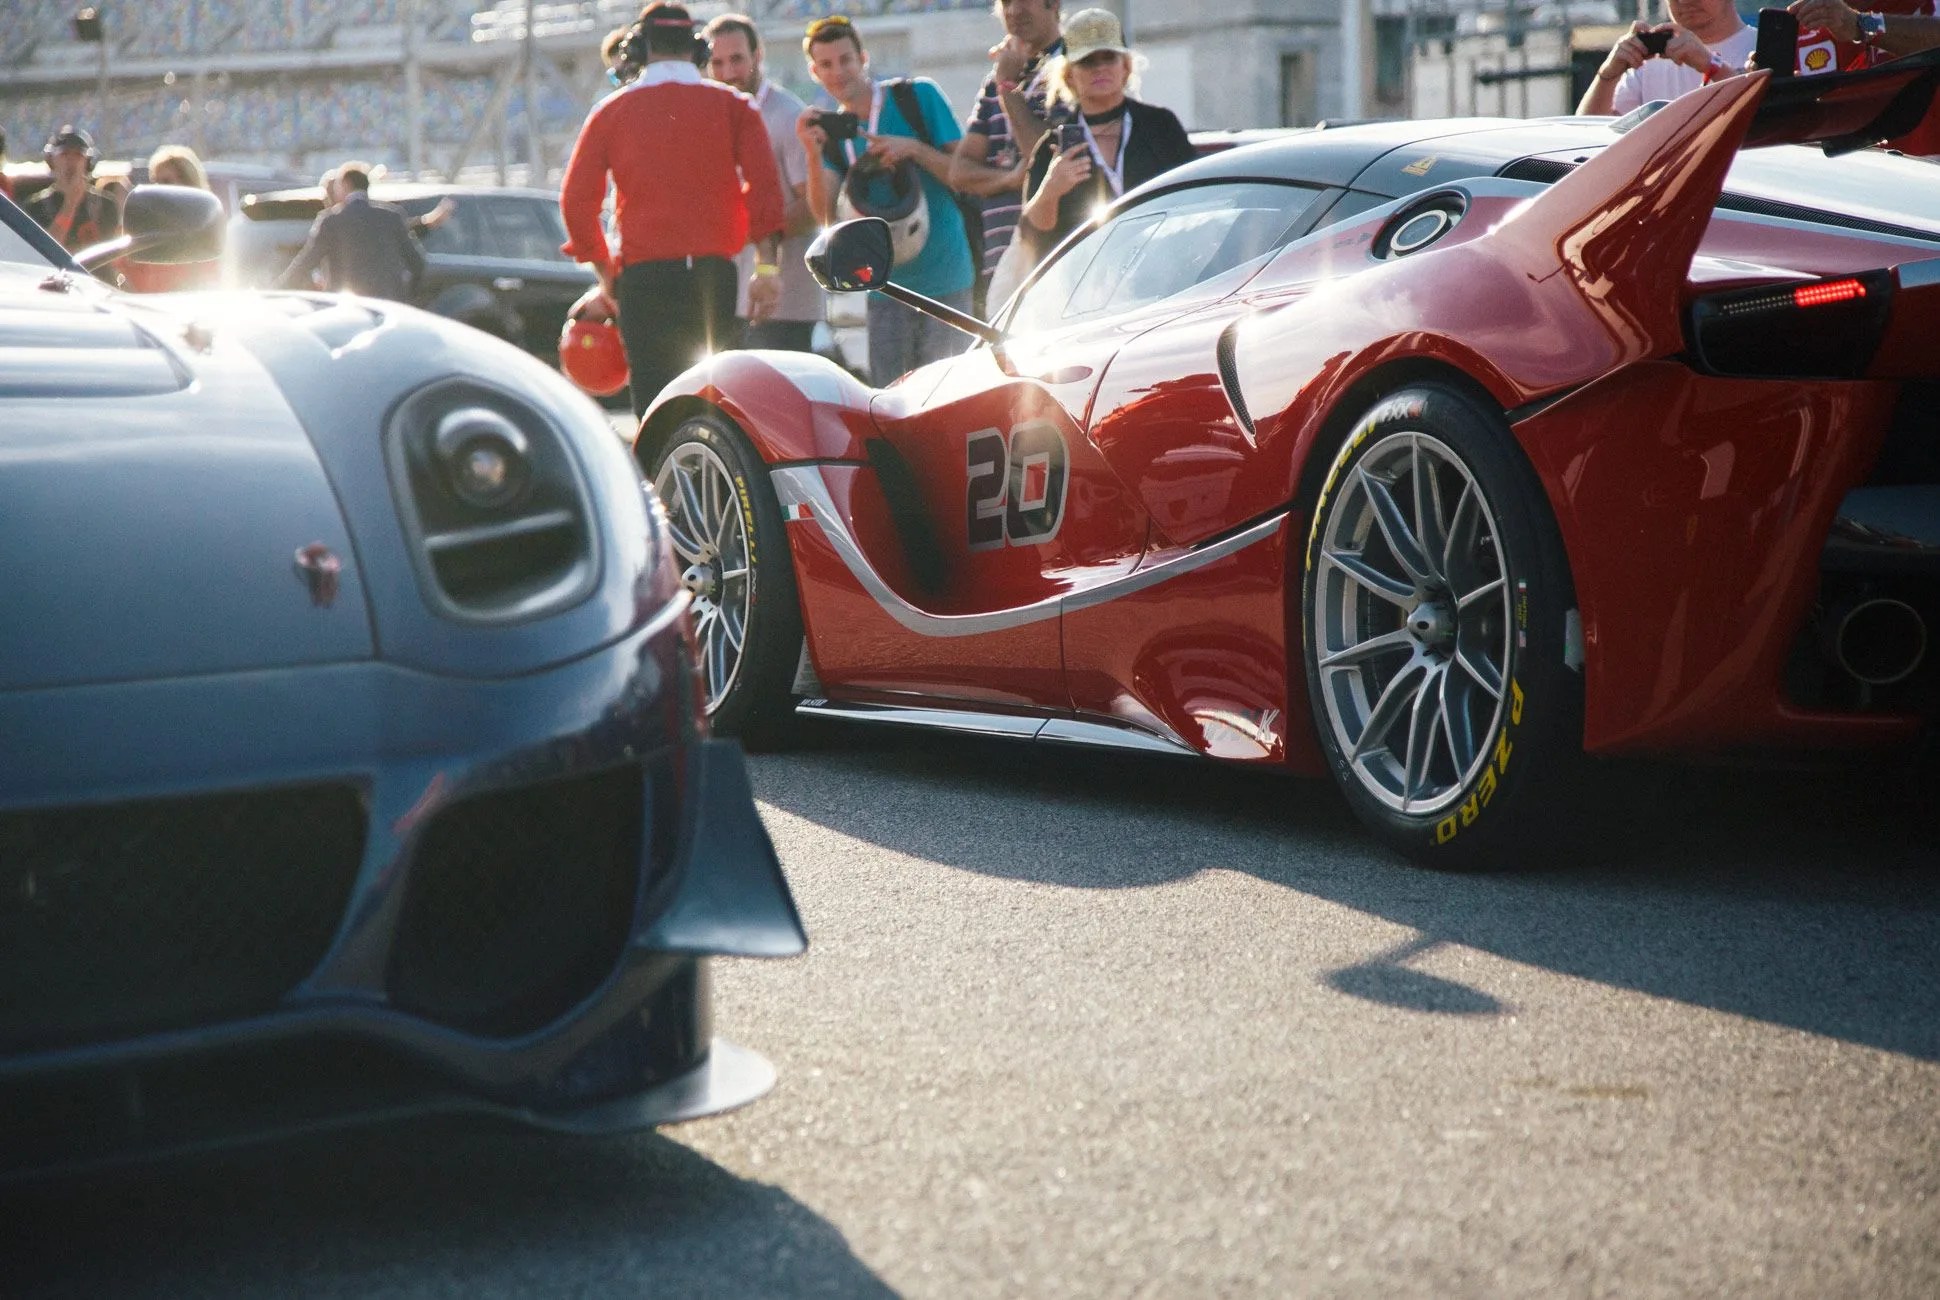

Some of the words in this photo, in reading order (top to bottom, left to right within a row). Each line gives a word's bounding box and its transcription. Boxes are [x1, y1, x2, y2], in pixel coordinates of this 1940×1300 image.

[735, 474, 758, 564] PIRELLI
[966, 419, 1070, 553] 20
[1511, 677, 1524, 726] P
[1436, 726, 1513, 845] ZERO
